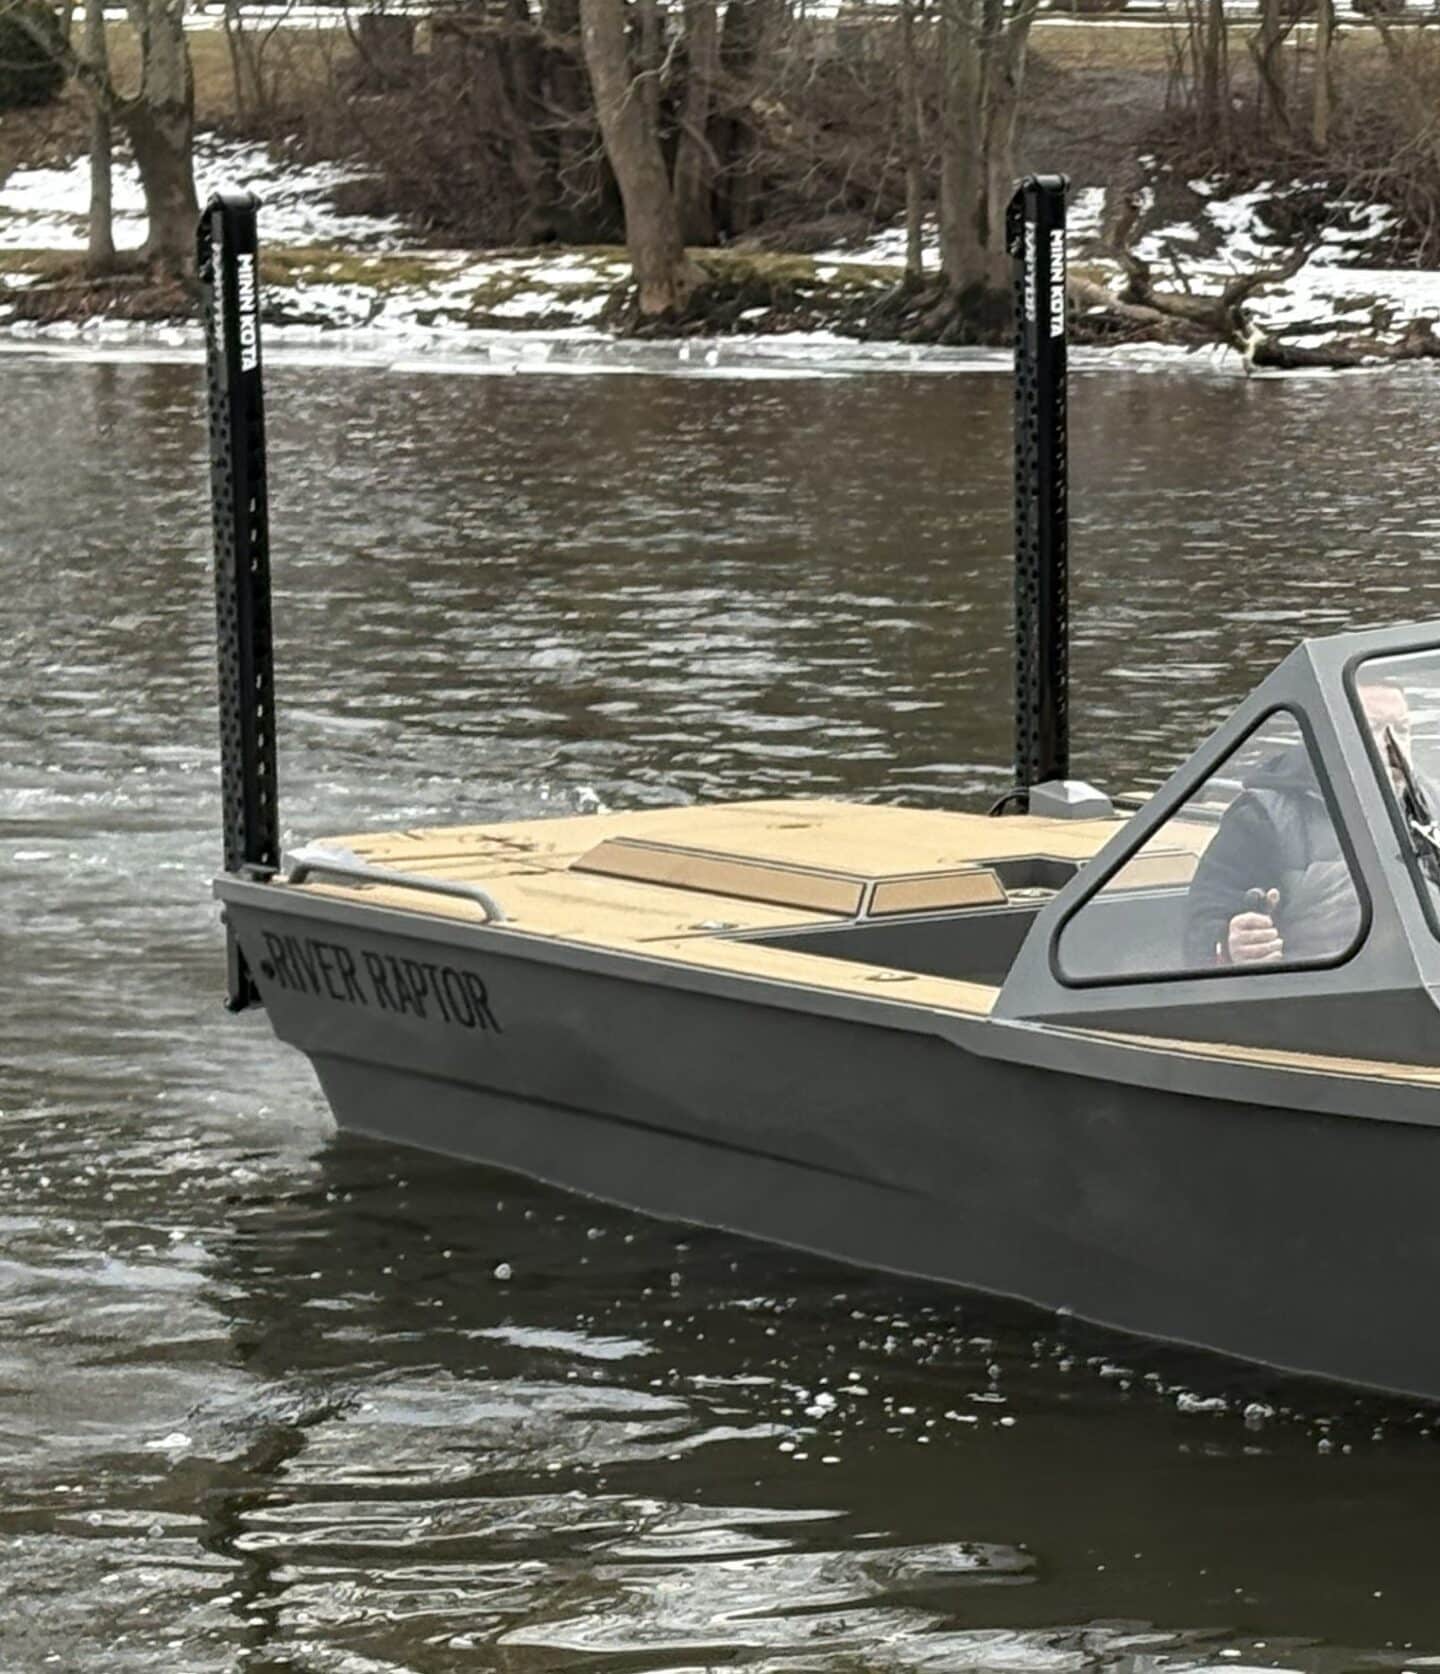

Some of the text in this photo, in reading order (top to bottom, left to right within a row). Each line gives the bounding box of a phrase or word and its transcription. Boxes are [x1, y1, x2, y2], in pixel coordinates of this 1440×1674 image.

[236, 253, 258, 372] MINN KOTA
[1050, 229, 1065, 338] MINN KOTA
[261, 930, 503, 1035] RIVER RAPTOR
